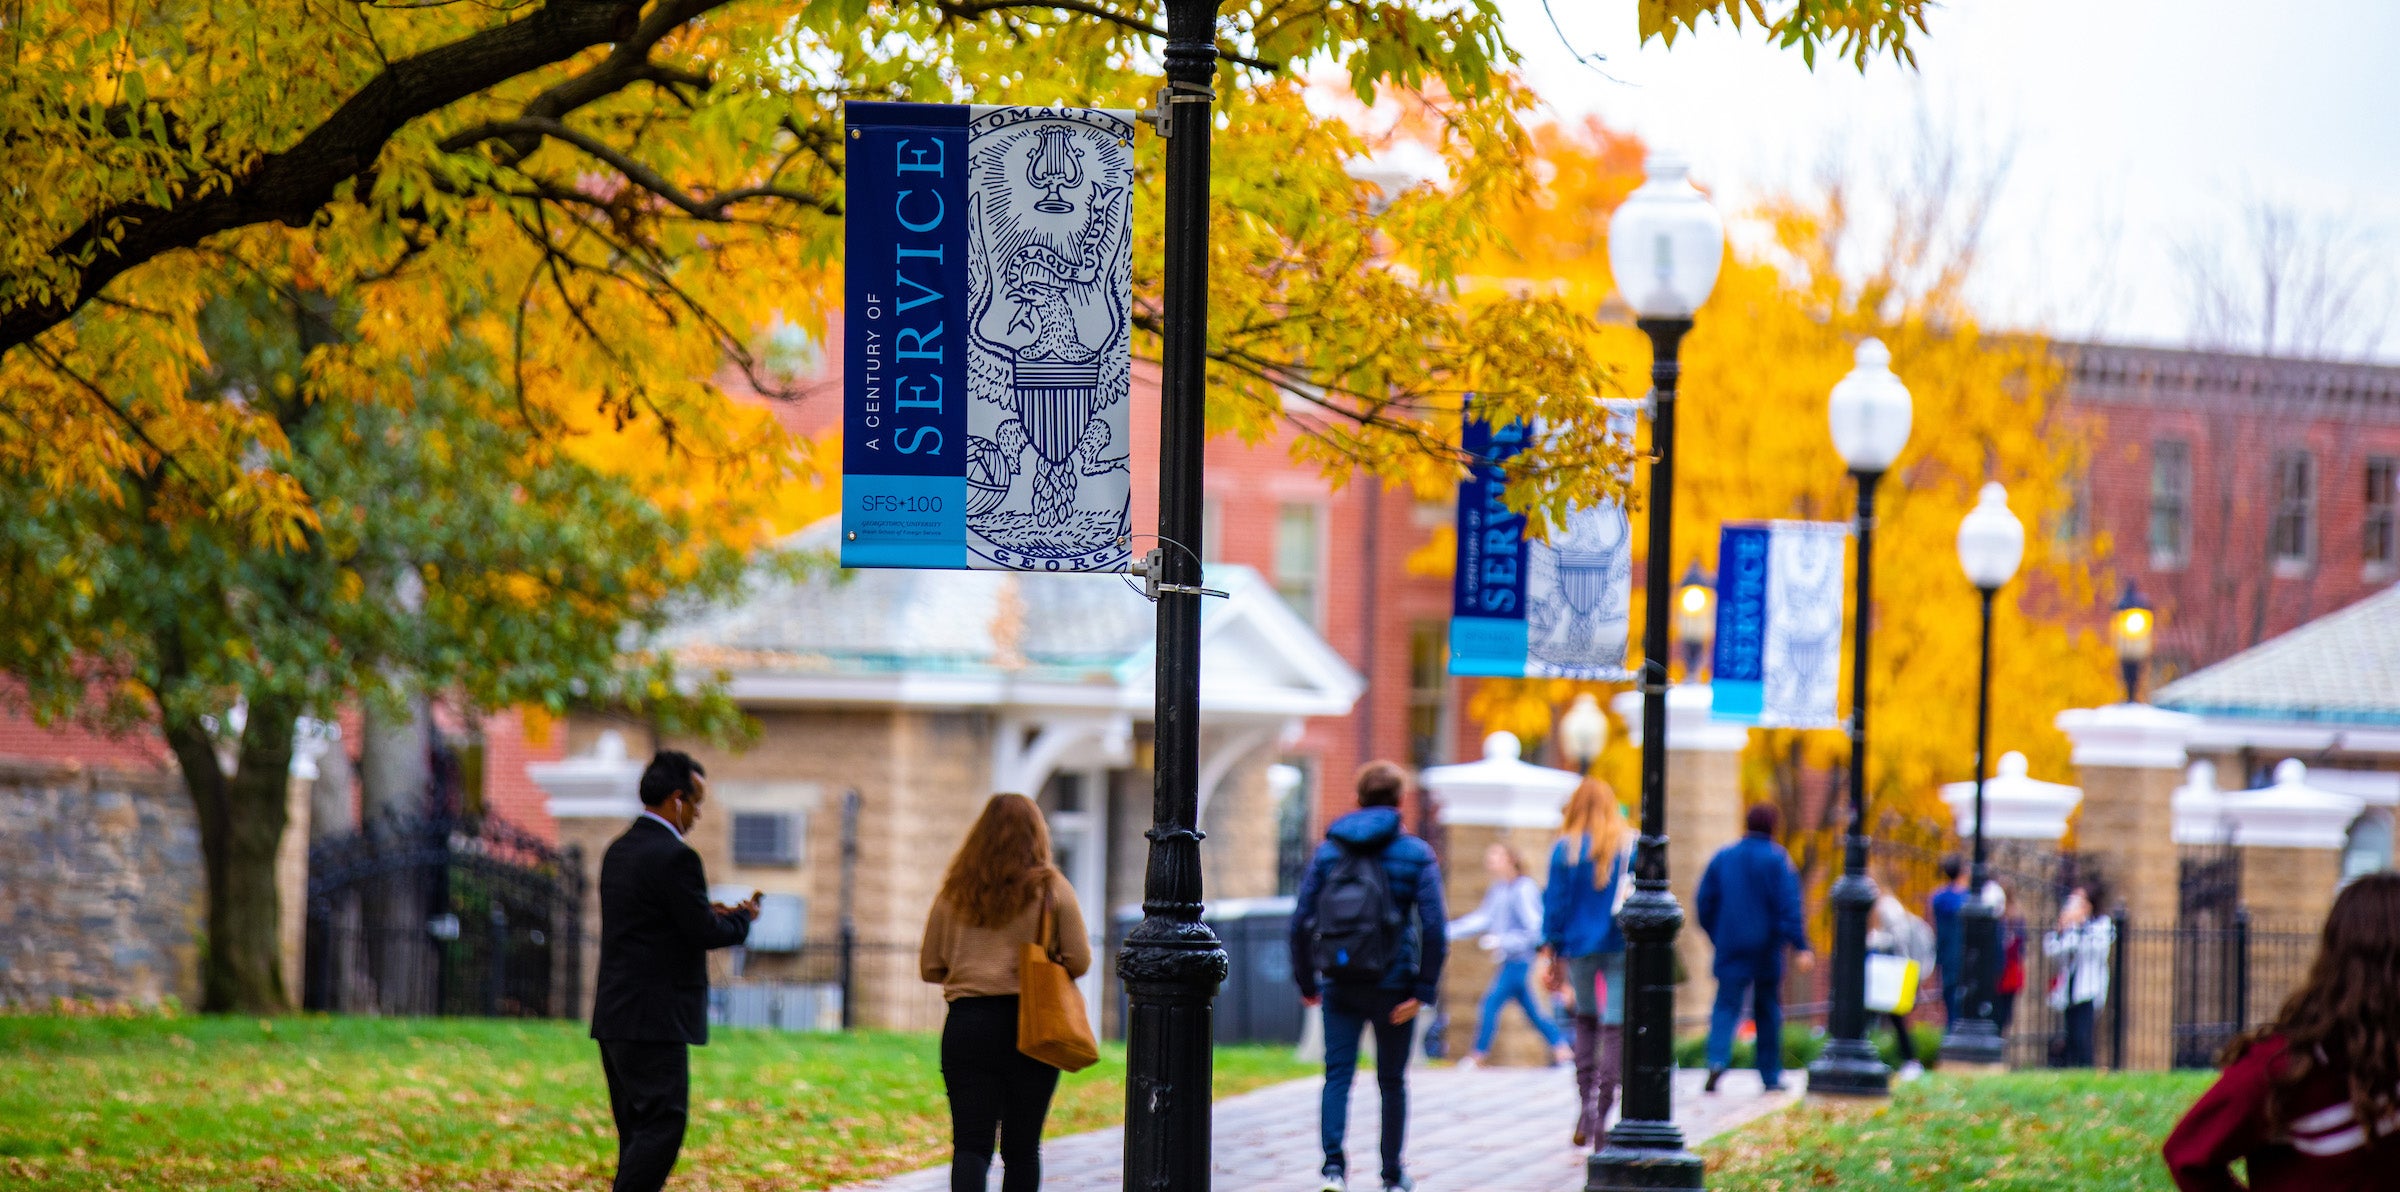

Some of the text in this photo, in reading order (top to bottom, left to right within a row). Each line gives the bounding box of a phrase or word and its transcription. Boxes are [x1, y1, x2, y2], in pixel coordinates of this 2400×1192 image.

[893, 136, 945, 456] SERVICE
[1008, 204, 1105, 284] UTRAQUE UNUM
[865, 293, 881, 450] A CENTURY OF
